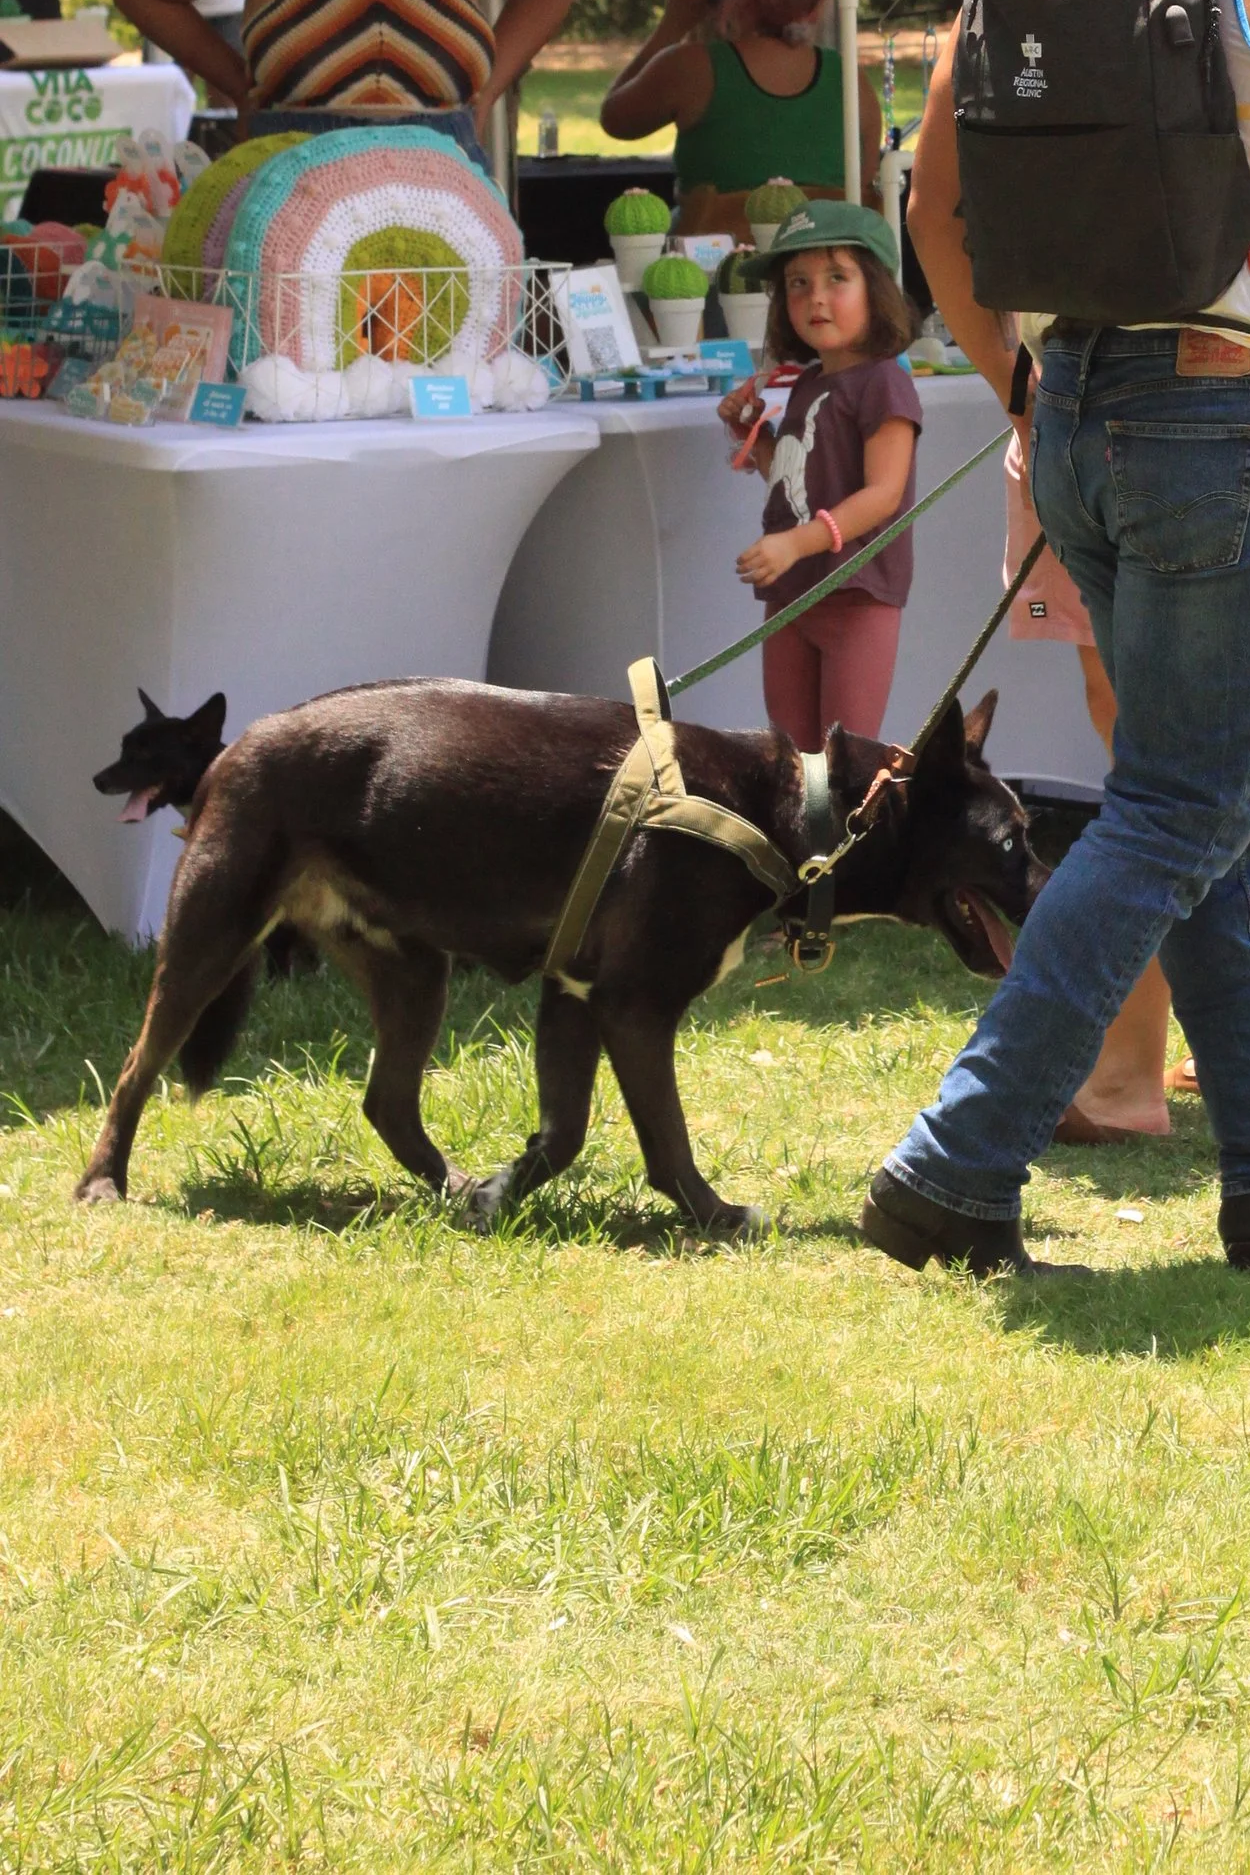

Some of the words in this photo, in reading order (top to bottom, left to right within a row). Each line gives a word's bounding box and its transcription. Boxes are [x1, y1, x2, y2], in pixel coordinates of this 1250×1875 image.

[1020, 67, 1044, 78] AUSTIN
[1013, 76, 1048, 89] REGIONAL
[1016, 86, 1042, 98] CLINIC
[25, 96, 103, 125] COCO
